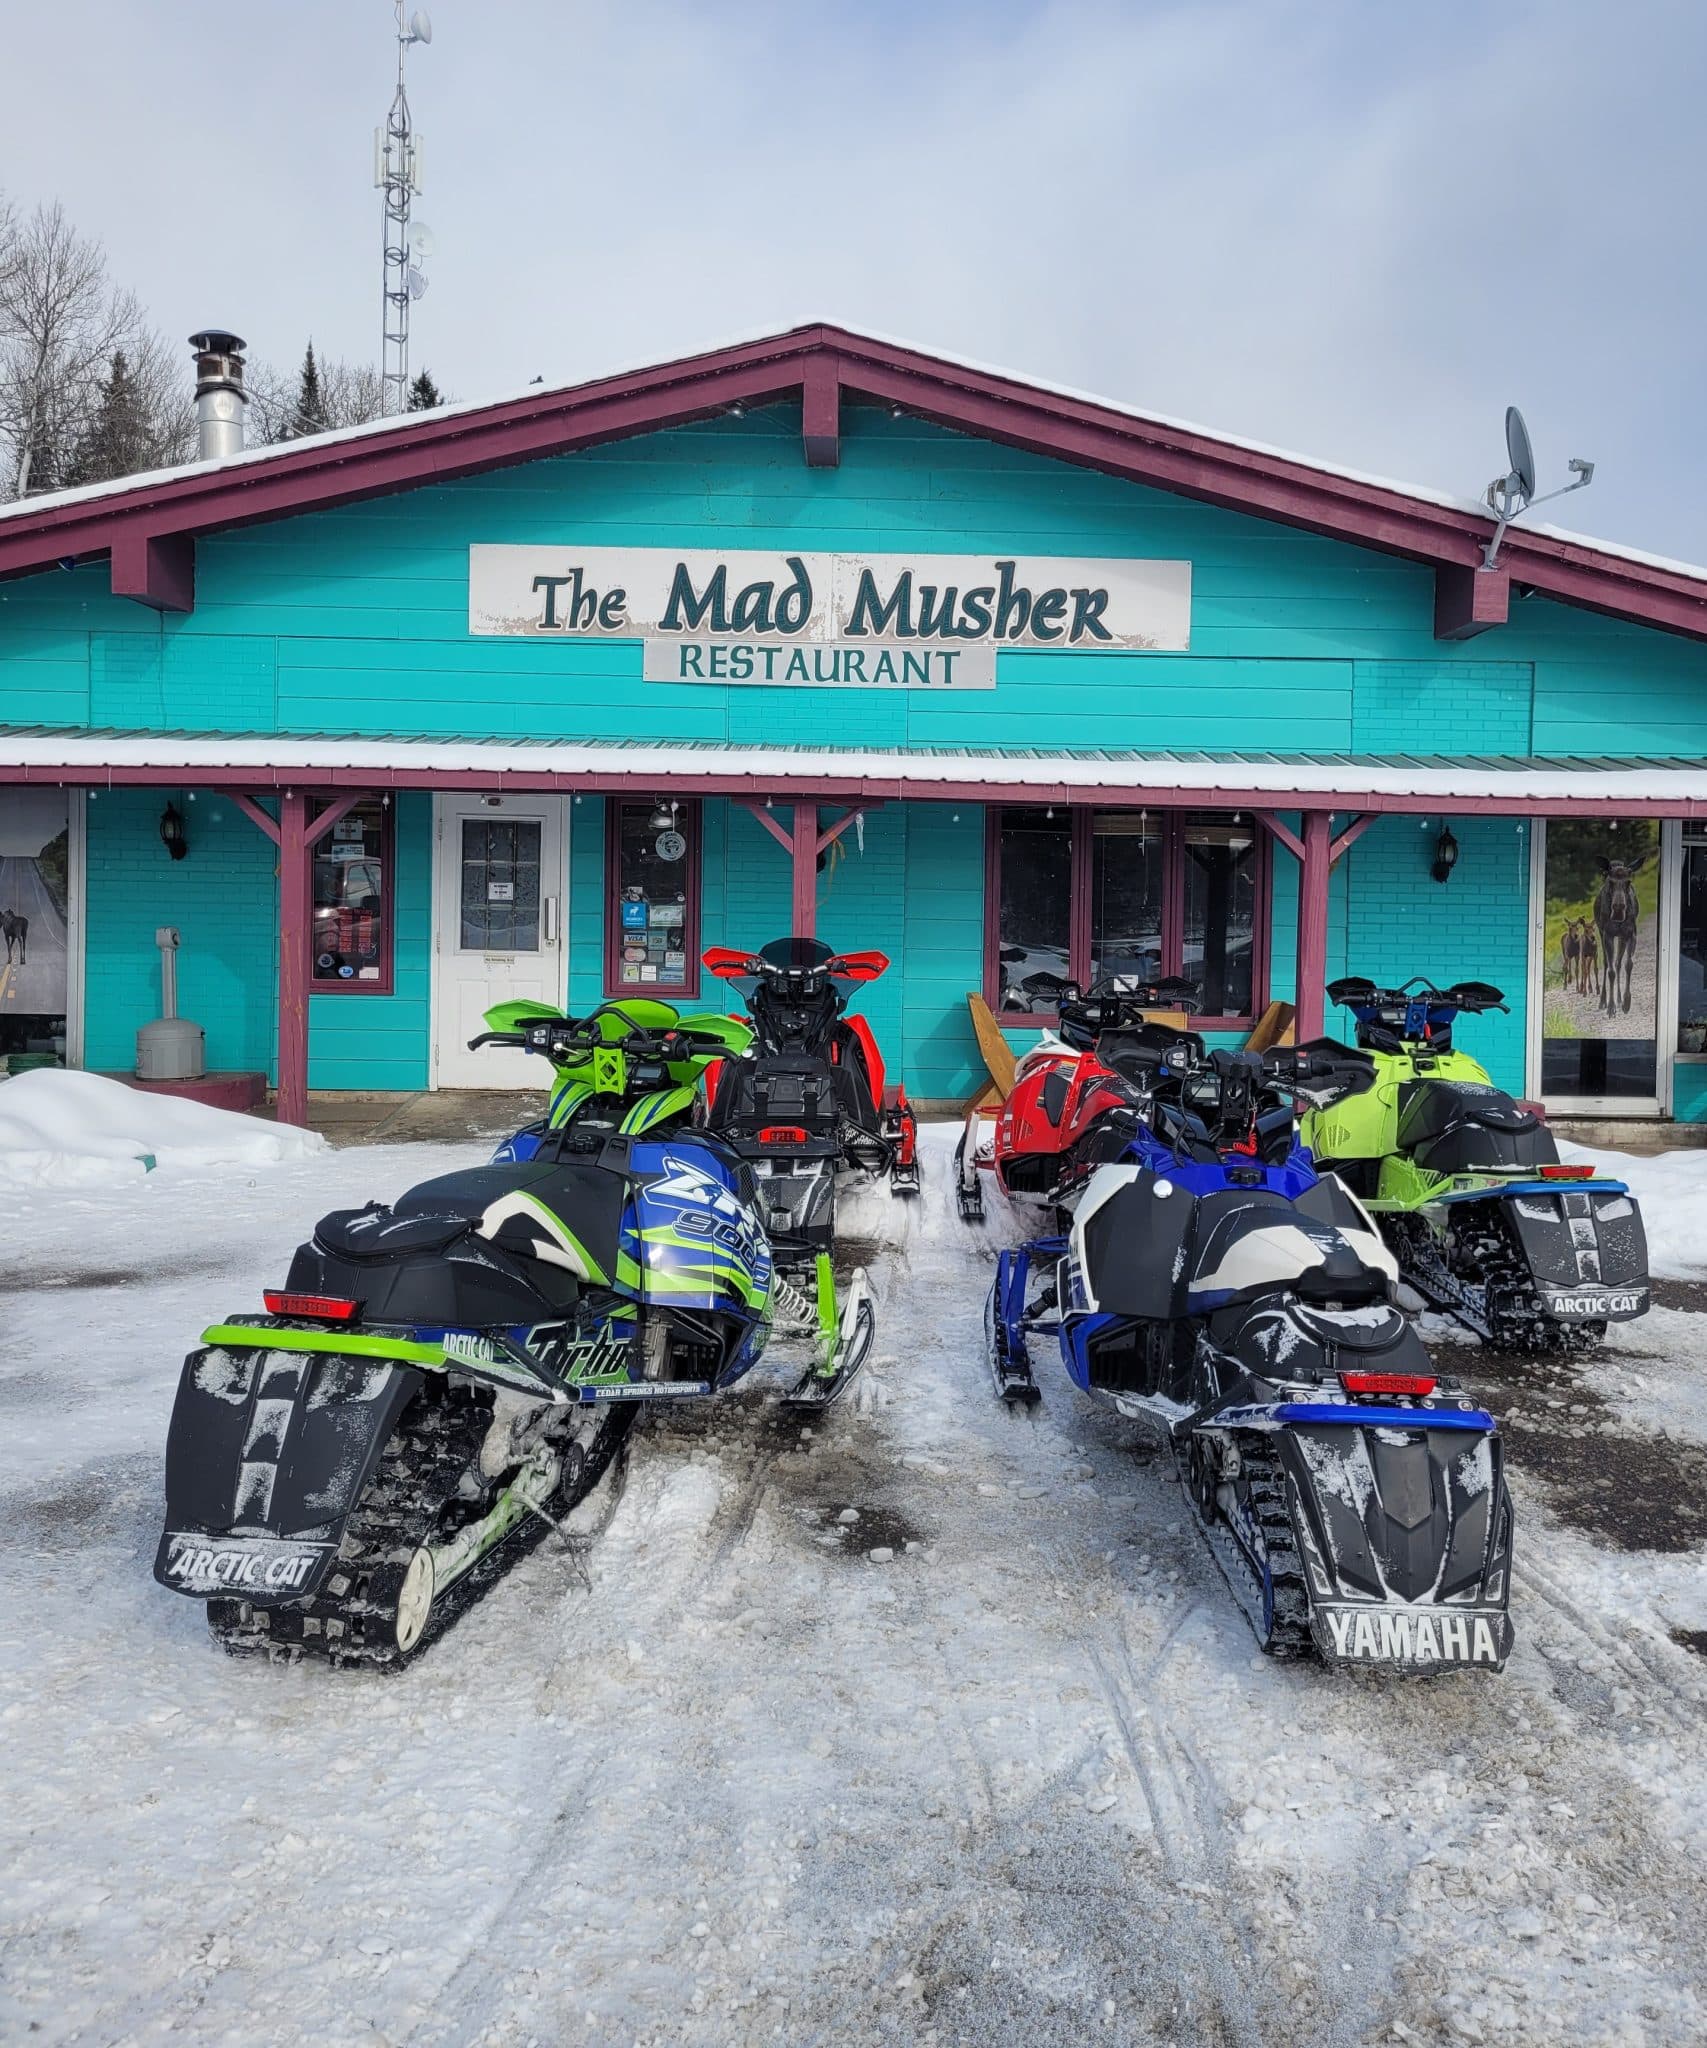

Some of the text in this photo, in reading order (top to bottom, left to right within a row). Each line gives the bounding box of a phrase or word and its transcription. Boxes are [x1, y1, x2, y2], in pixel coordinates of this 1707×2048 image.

[532, 567, 626, 629] The
[658, 557, 813, 634] Mad
[679, 644, 961, 684] RESTAURANT
[1554, 1295, 1639, 1312] ARCTIC CAT
[443, 1333, 478, 1358] ARCTIC
[595, 1388, 620, 1397] CEDAR
[622, 1386, 653, 1396] SPRINGS
[168, 1548, 315, 1587] ARCTIC CAT
[1325, 1612, 1498, 1662] YAMAHA
